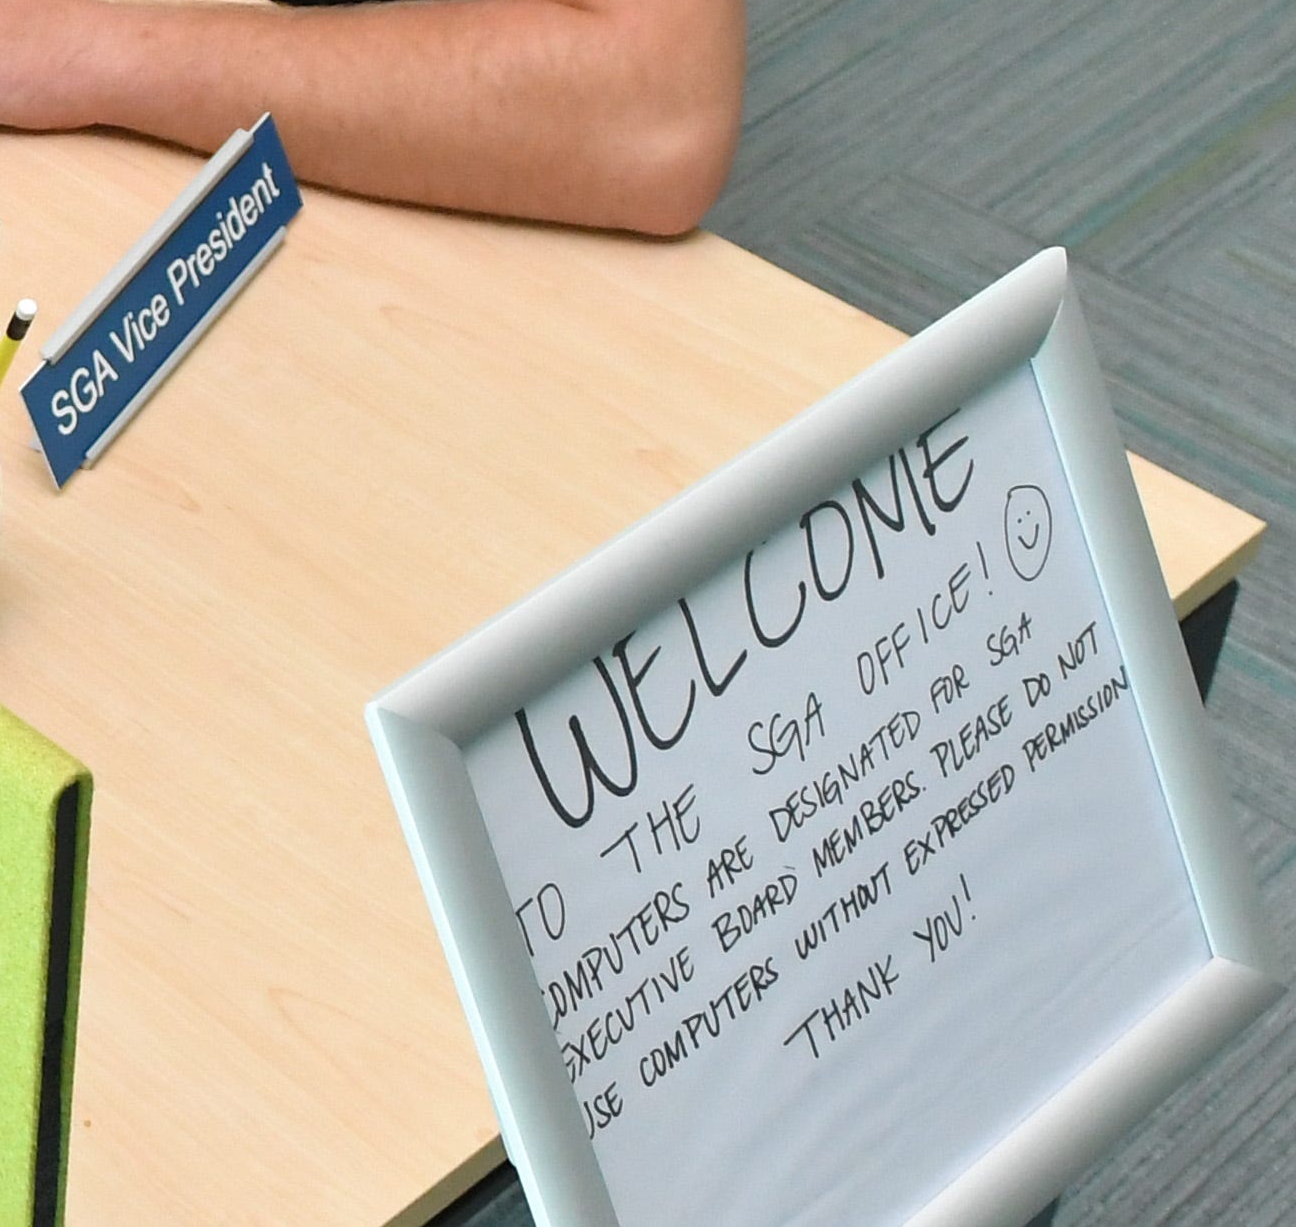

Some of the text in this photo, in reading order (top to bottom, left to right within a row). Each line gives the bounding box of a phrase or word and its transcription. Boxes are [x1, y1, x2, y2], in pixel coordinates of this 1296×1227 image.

[50, 161, 282, 436] SGA Vice President
[513, 408, 975, 829] WELCOME
[599, 783, 702, 875] THE
[747, 691, 827, 776] SGA
[855, 540, 995, 696] OFFICE!
[707, 834, 755, 899] ARE
[768, 710, 923, 843] DESIGNATED
[929, 664, 971, 715] FOR
[986, 611, 1033, 667] SGA
[639, 956, 780, 1088] COMPUTERS
[794, 860, 892, 960] WITHOUT
[903, 764, 1016, 876] EXPRESSED
[1021, 664, 1130, 773] PERMISSION
[710, 873, 799, 953] BOARD
[811, 769, 927, 879] MEMBERS.
[929, 694, 1013, 778] PLEASE
[1022, 672, 1052, 708] DO
[1057, 620, 1098, 681] NOT
[782, 872, 978, 1059] THANK YOU!
